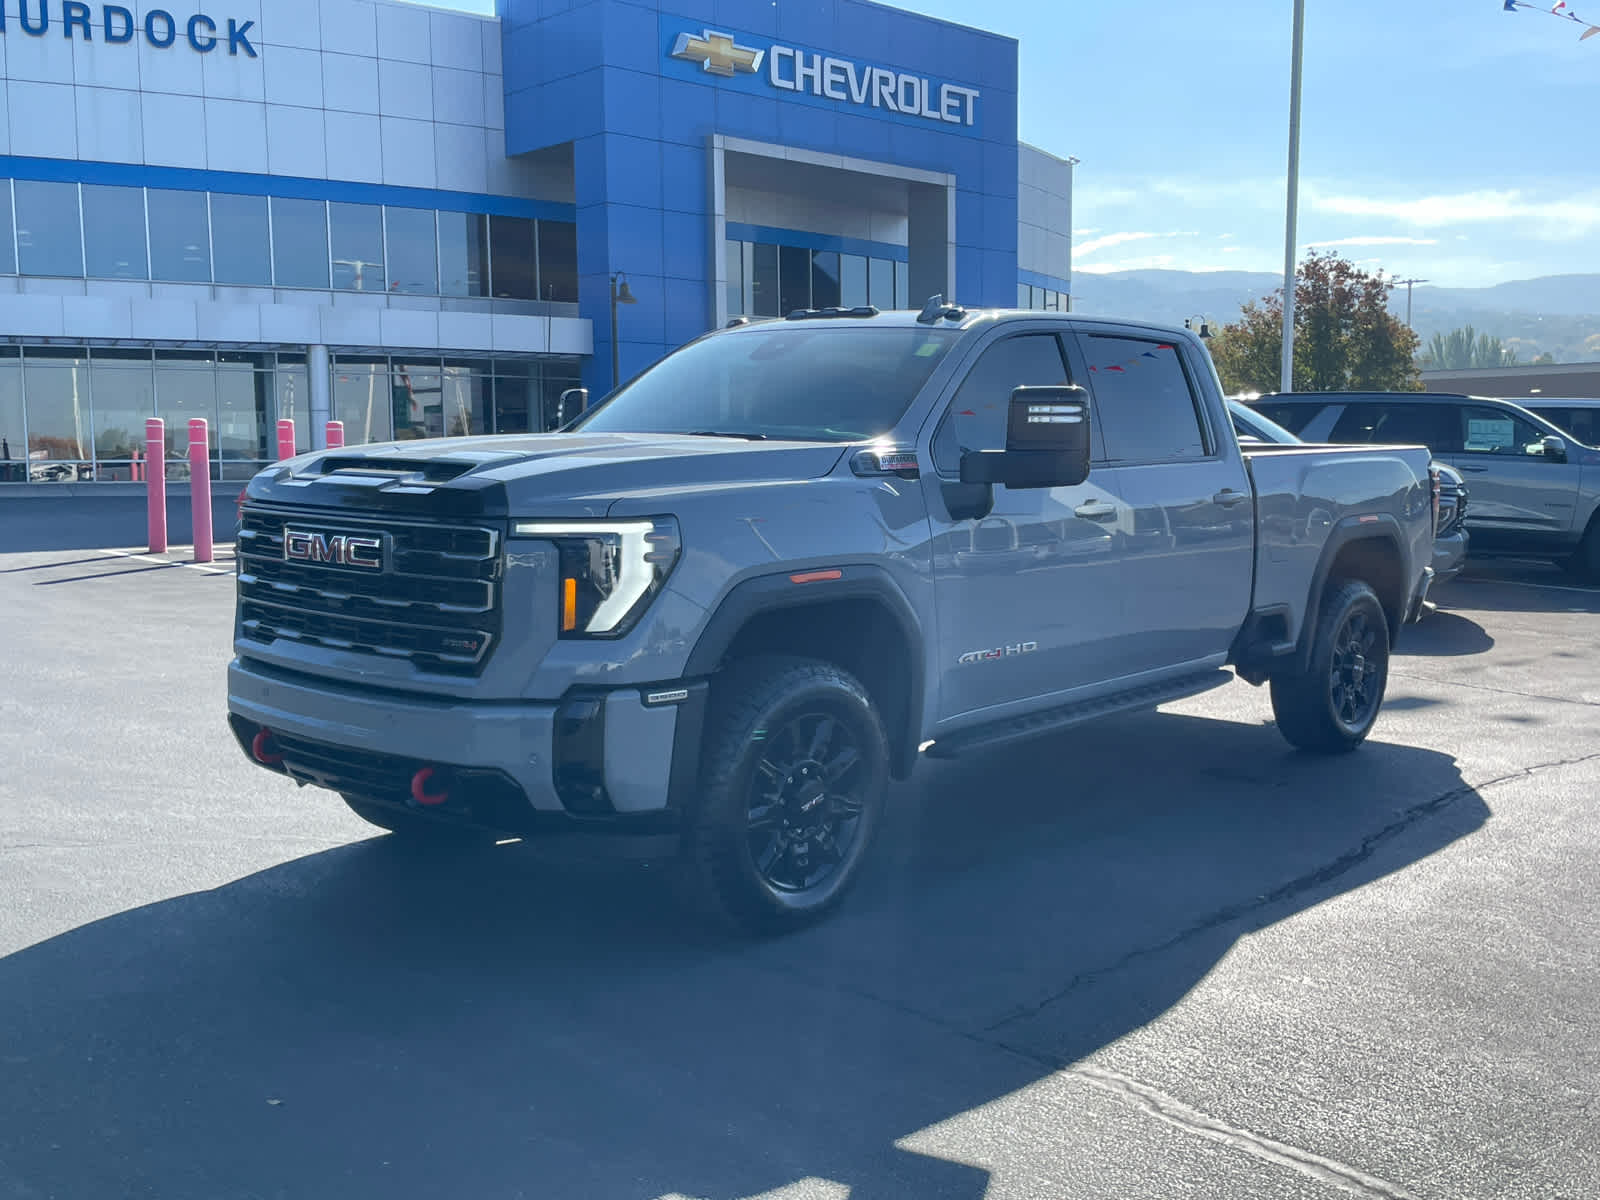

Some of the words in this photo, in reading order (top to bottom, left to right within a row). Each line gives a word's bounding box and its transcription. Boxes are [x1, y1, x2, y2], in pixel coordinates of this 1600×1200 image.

[0, 0, 257, 57] URDOCK
[770, 45, 980, 125] CHEVROLET
[284, 528, 380, 567] GMC
[1005, 641, 1037, 656] HD
